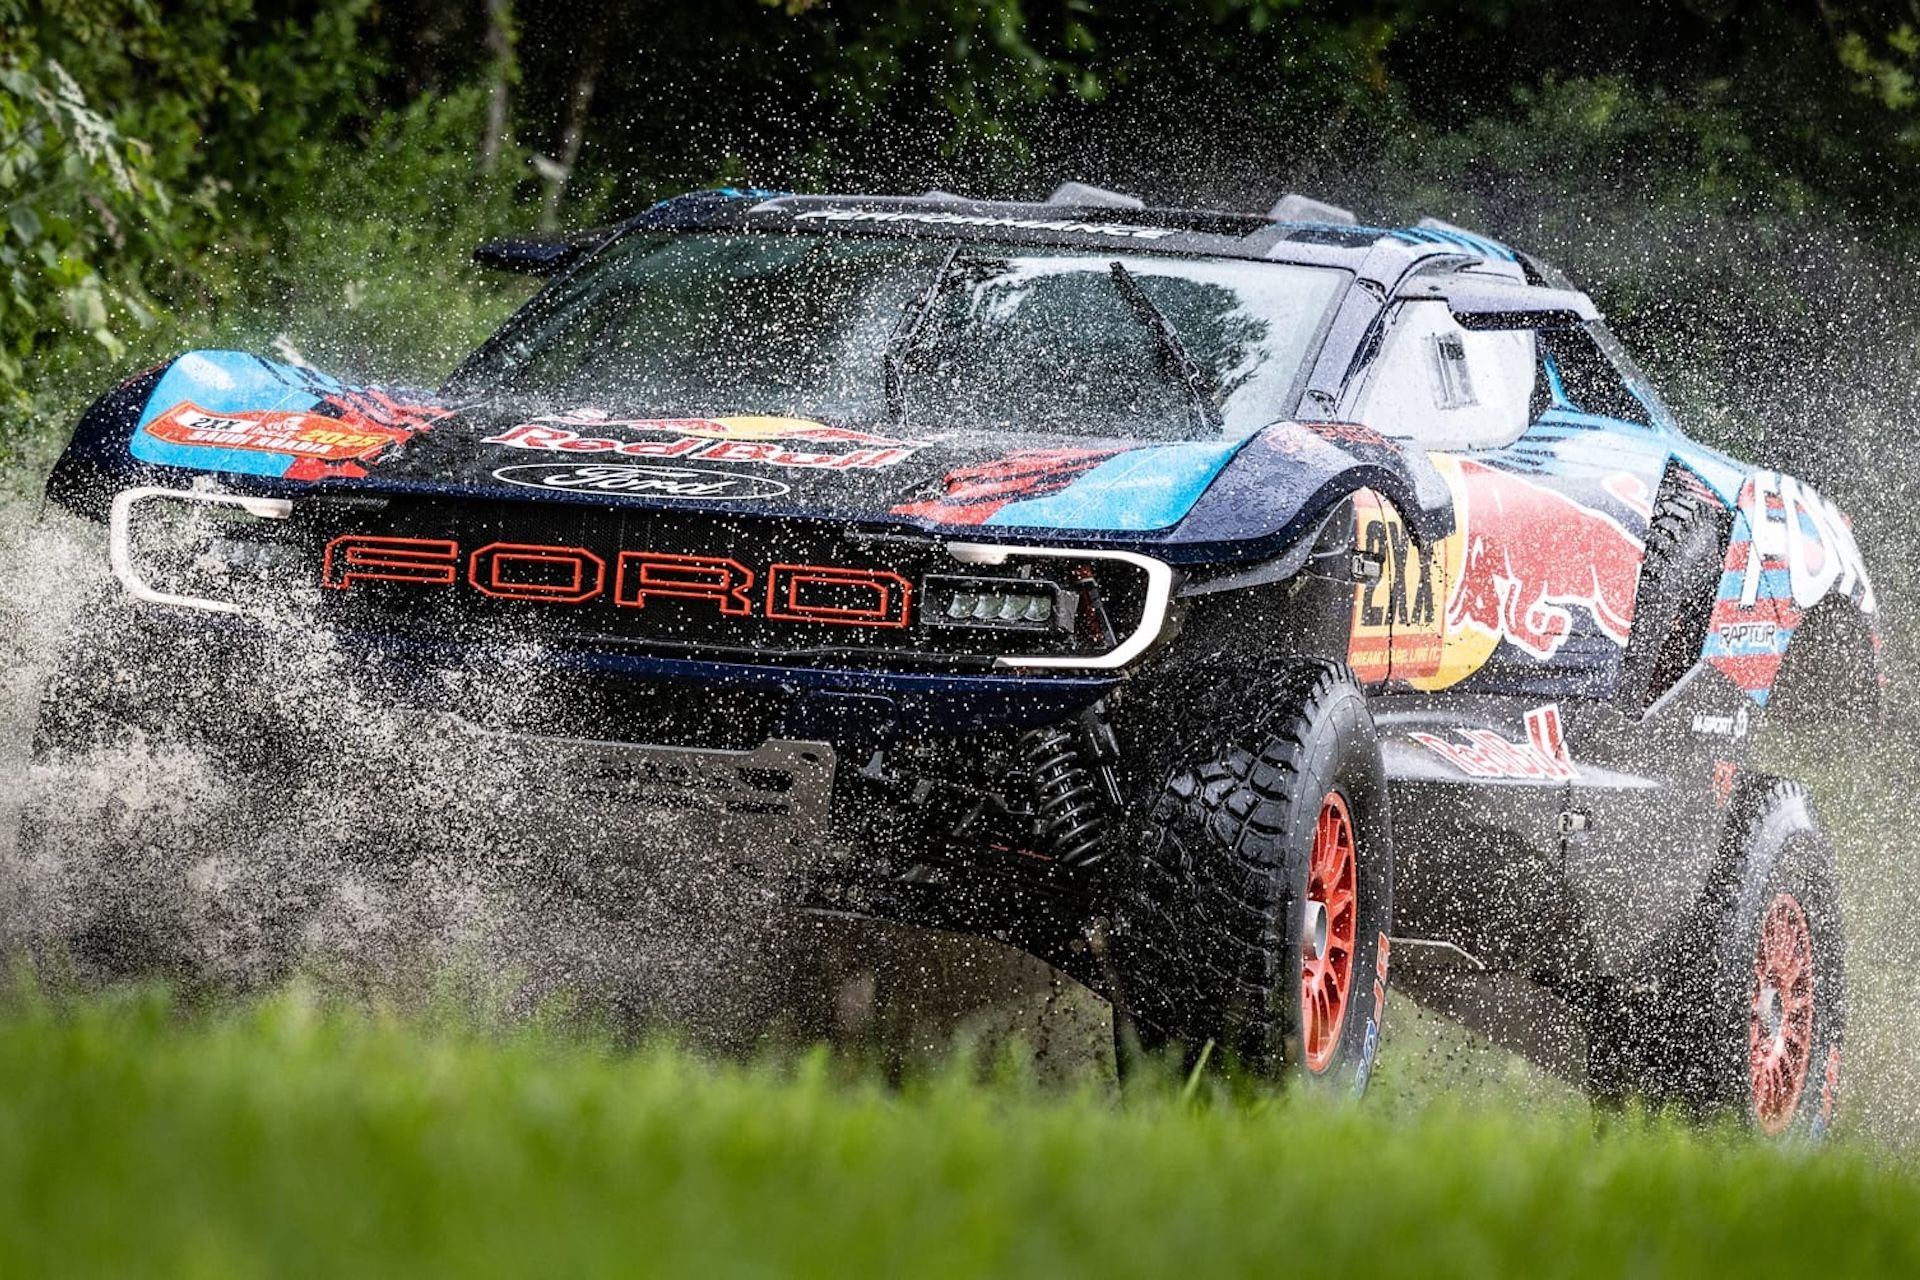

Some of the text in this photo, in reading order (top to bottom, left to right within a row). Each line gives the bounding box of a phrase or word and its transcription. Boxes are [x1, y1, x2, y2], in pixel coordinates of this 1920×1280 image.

[191, 417, 240, 431] 2XX
[301, 430, 382, 447] 2025
[187, 430, 334, 454] SAUDI ARABIA
[480, 424, 922, 470] Red Bull
[543, 464, 737, 496] Ford
[323, 534, 914, 629] FORD
[1361, 520, 1435, 627] 2XX
